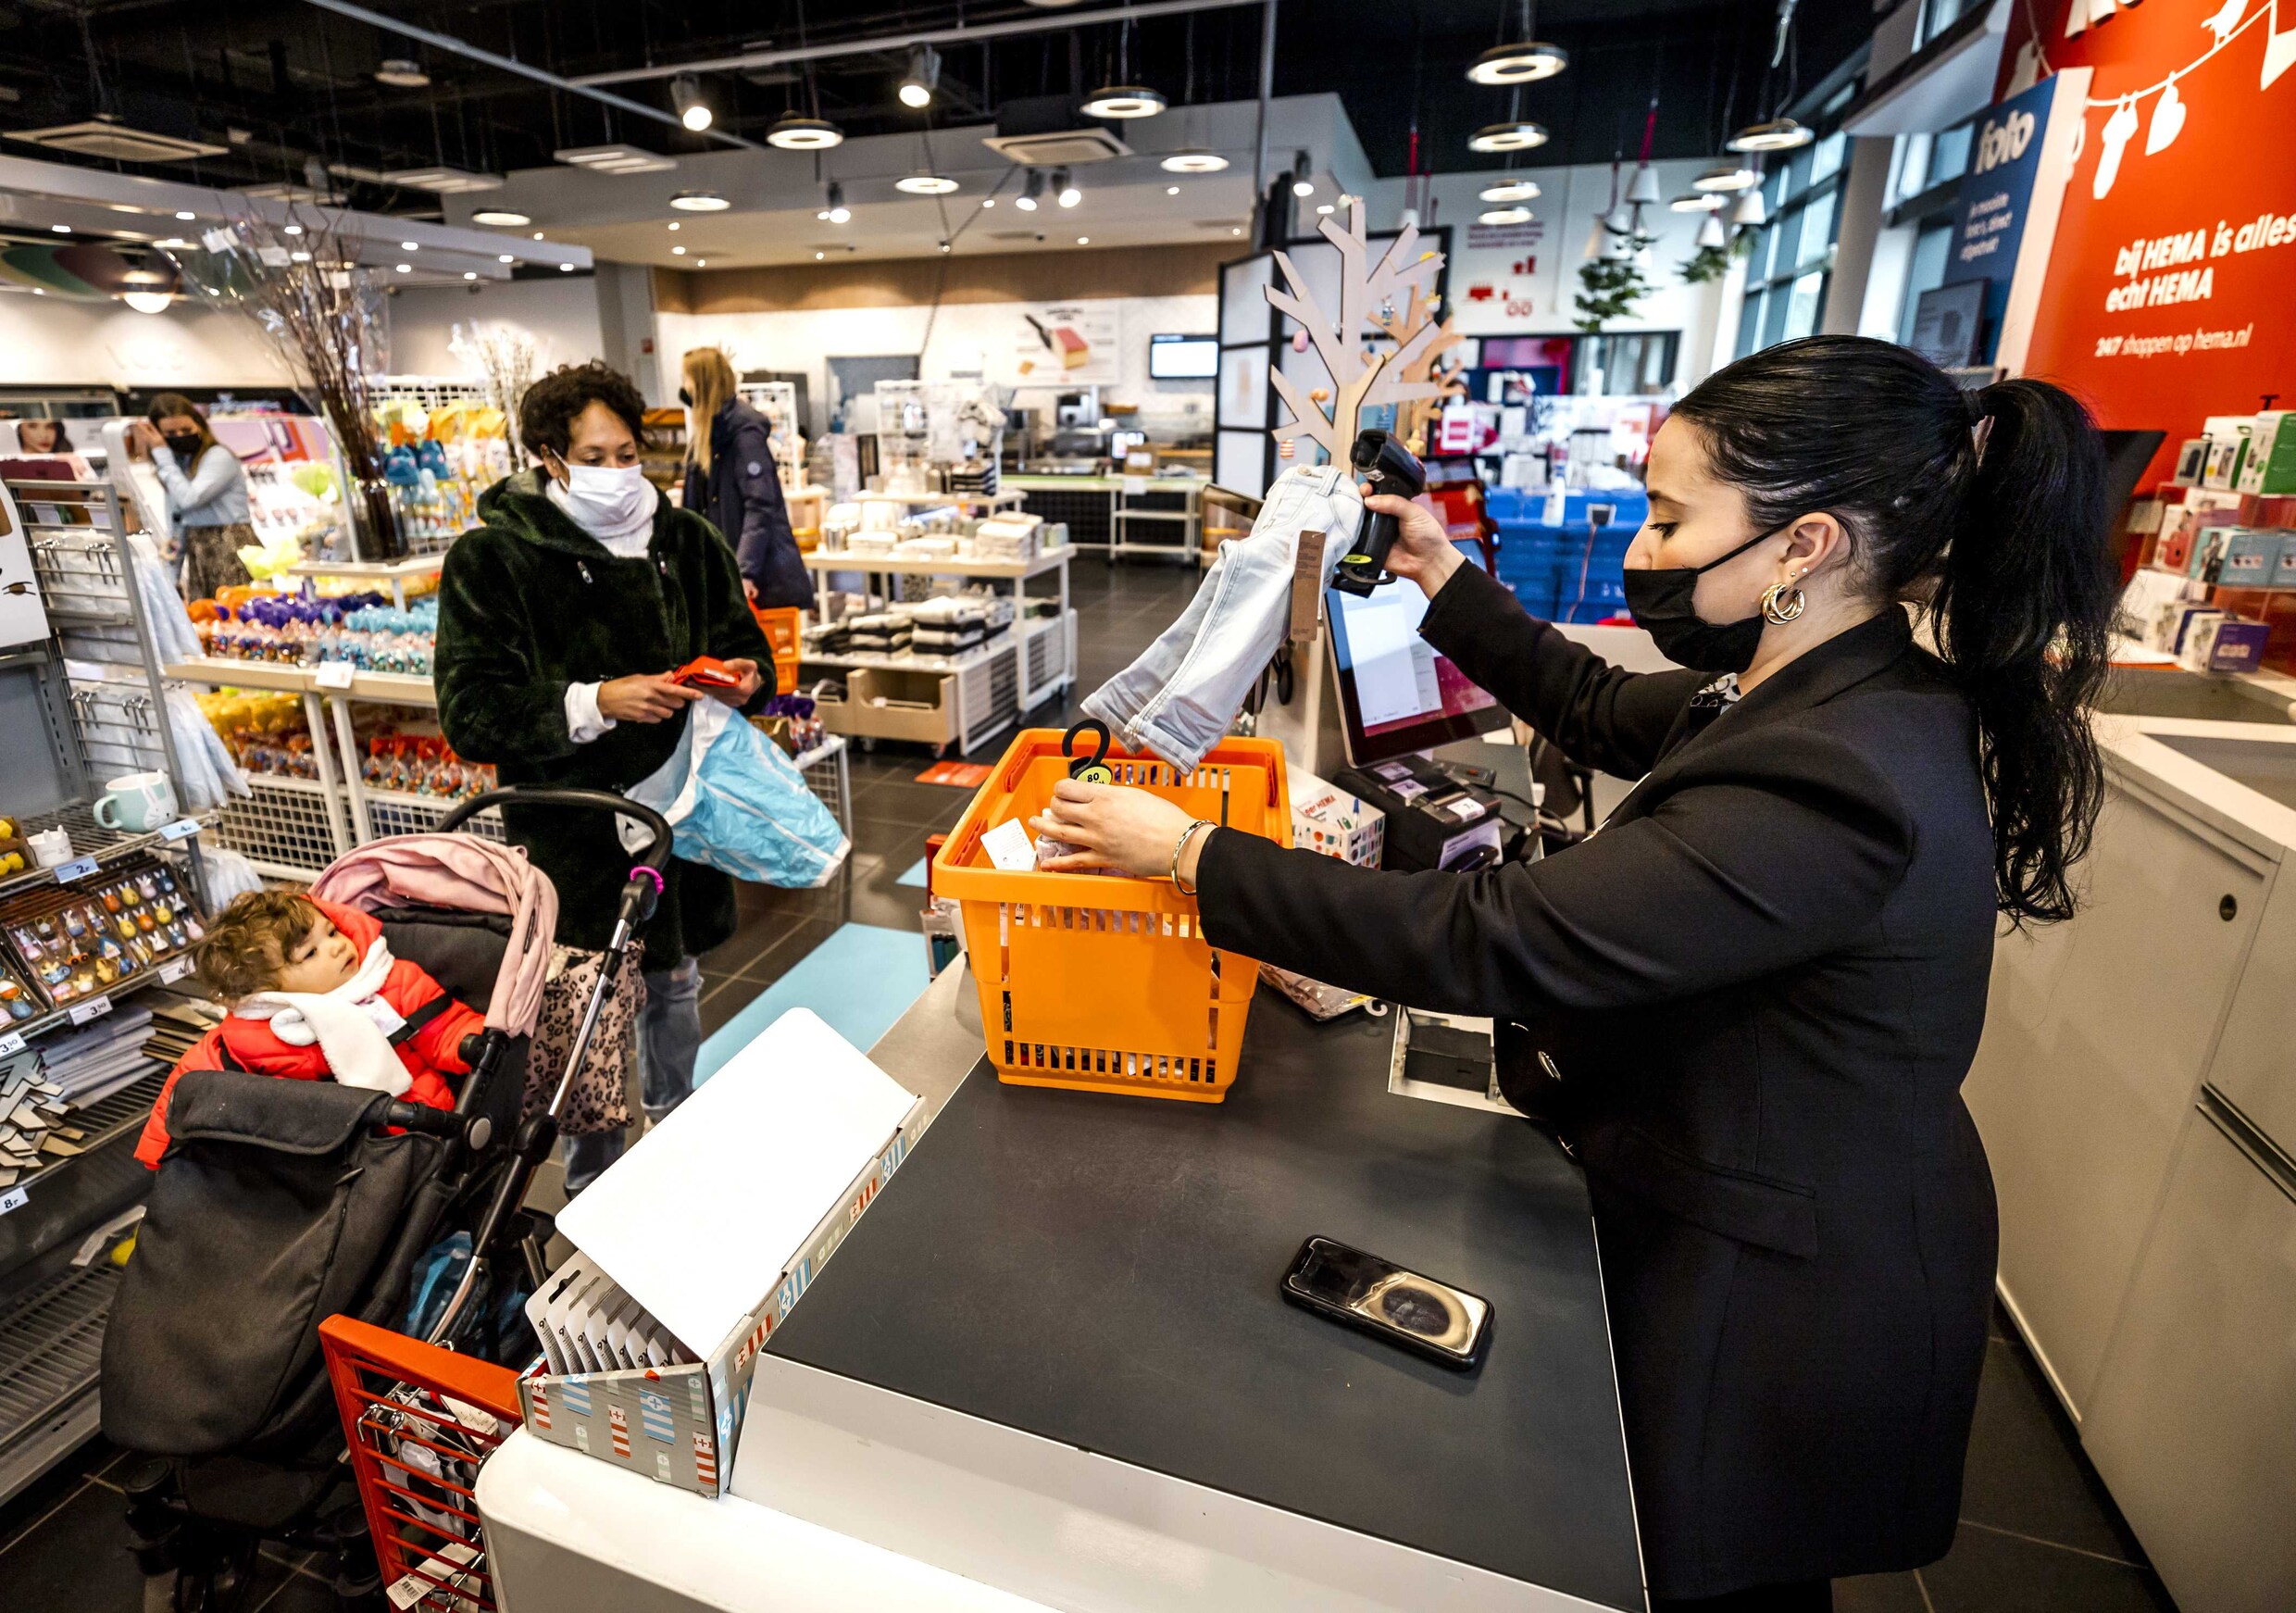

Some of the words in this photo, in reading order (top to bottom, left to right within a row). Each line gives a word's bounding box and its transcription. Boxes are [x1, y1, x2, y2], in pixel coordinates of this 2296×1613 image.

[2114, 238, 2145, 279] bij
[2140, 228, 2207, 270] HEMA
[2209, 219, 2234, 258] is
[2233, 213, 2296, 254] alles
[2105, 277, 2150, 312] echt
[2147, 267, 2214, 306] HEMA
[2121, 332, 2173, 359] shoppen
[2172, 333, 2193, 357] op
[2192, 322, 2253, 351] hema.nl
[1087, 772, 1100, 783] 80
